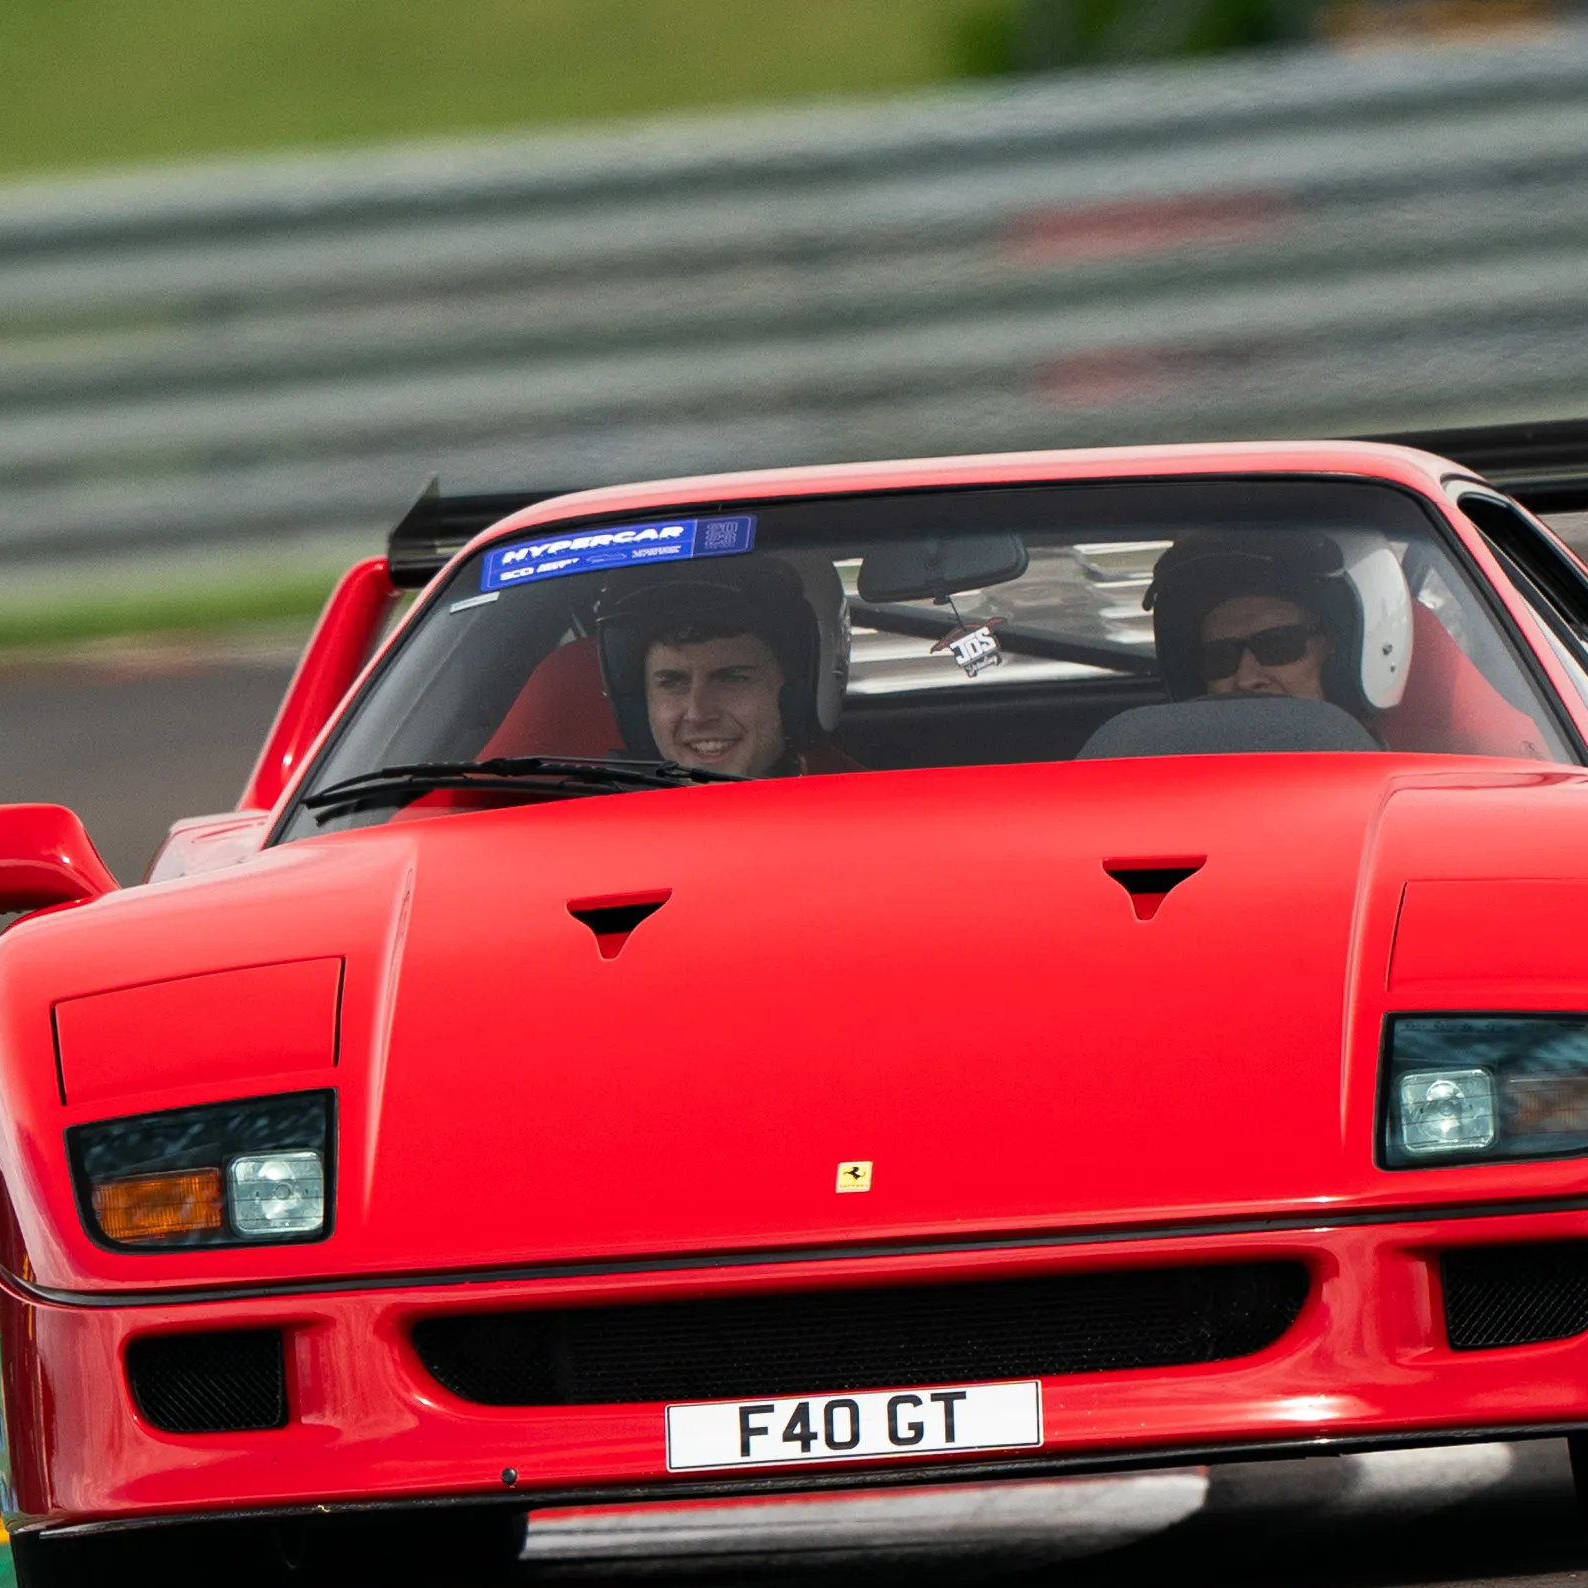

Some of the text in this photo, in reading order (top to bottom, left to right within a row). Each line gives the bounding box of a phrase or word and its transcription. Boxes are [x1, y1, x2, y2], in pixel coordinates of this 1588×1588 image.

[502, 526, 684, 565] HYPERCAR
[739, 1391, 967, 1457] F40 GT
